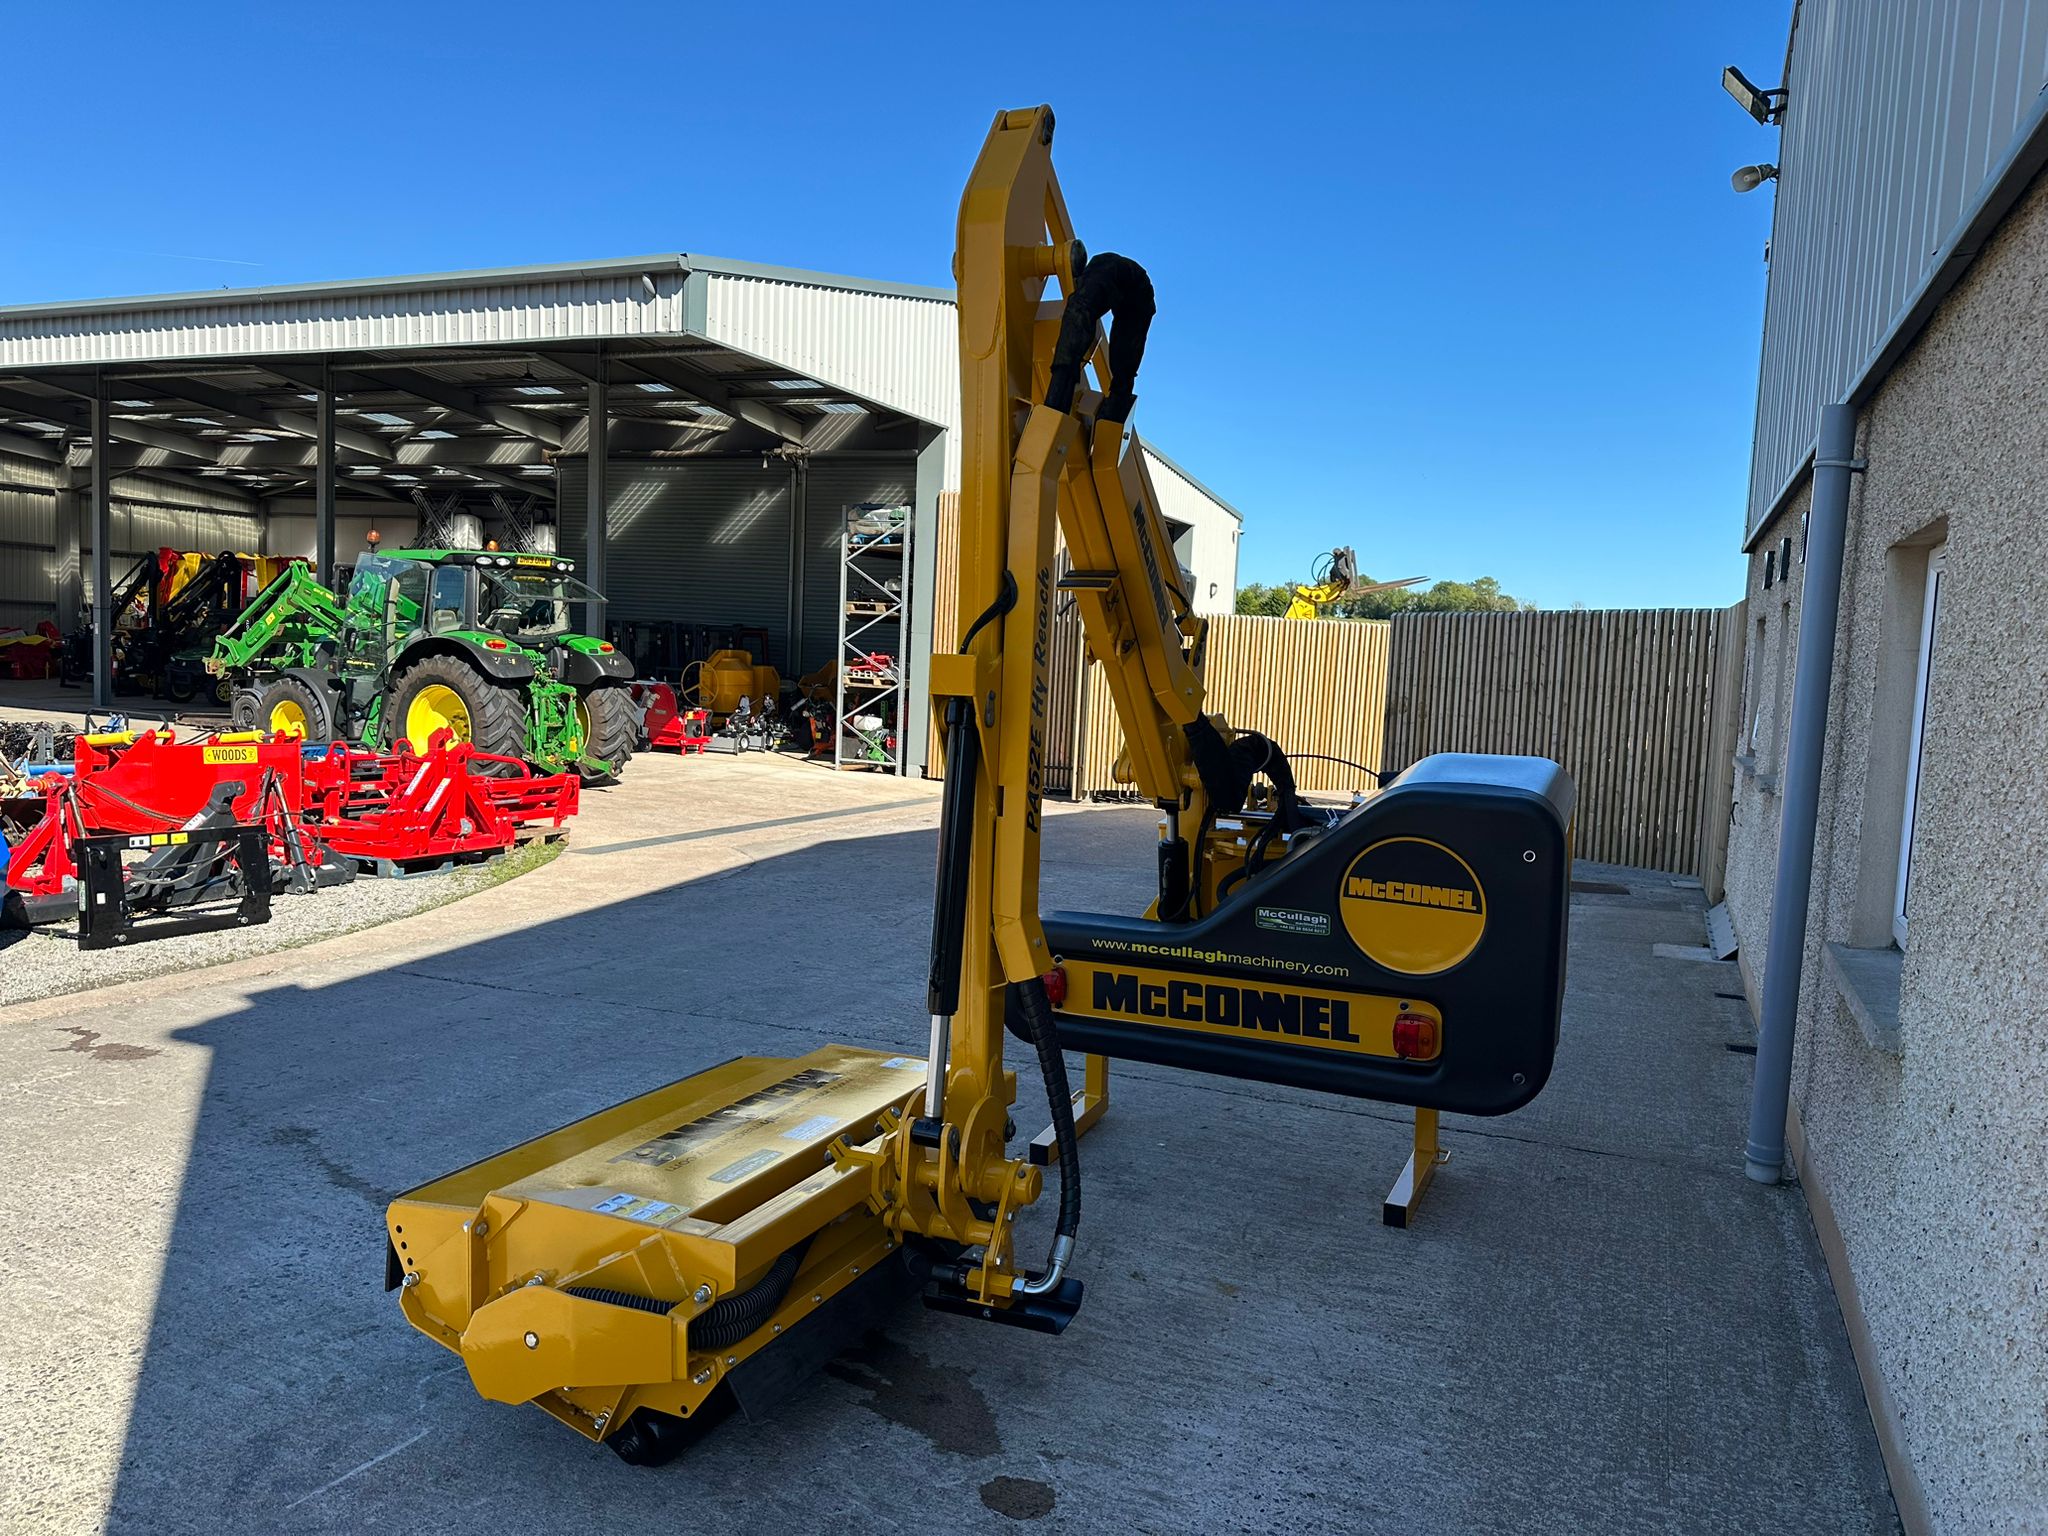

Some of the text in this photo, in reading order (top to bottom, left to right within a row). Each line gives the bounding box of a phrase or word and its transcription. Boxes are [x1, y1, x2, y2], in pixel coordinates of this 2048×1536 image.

[1026, 567, 1050, 833] PA52E Hy Reach
[212, 748, 247, 761] WOODS
[1349, 876, 1477, 911] McCONNEL
[1259, 909, 1327, 923] McCullagh
[1092, 938, 1349, 977] www.mccullaghmachinery.com
[1093, 971, 1360, 1043] McCONNEL
